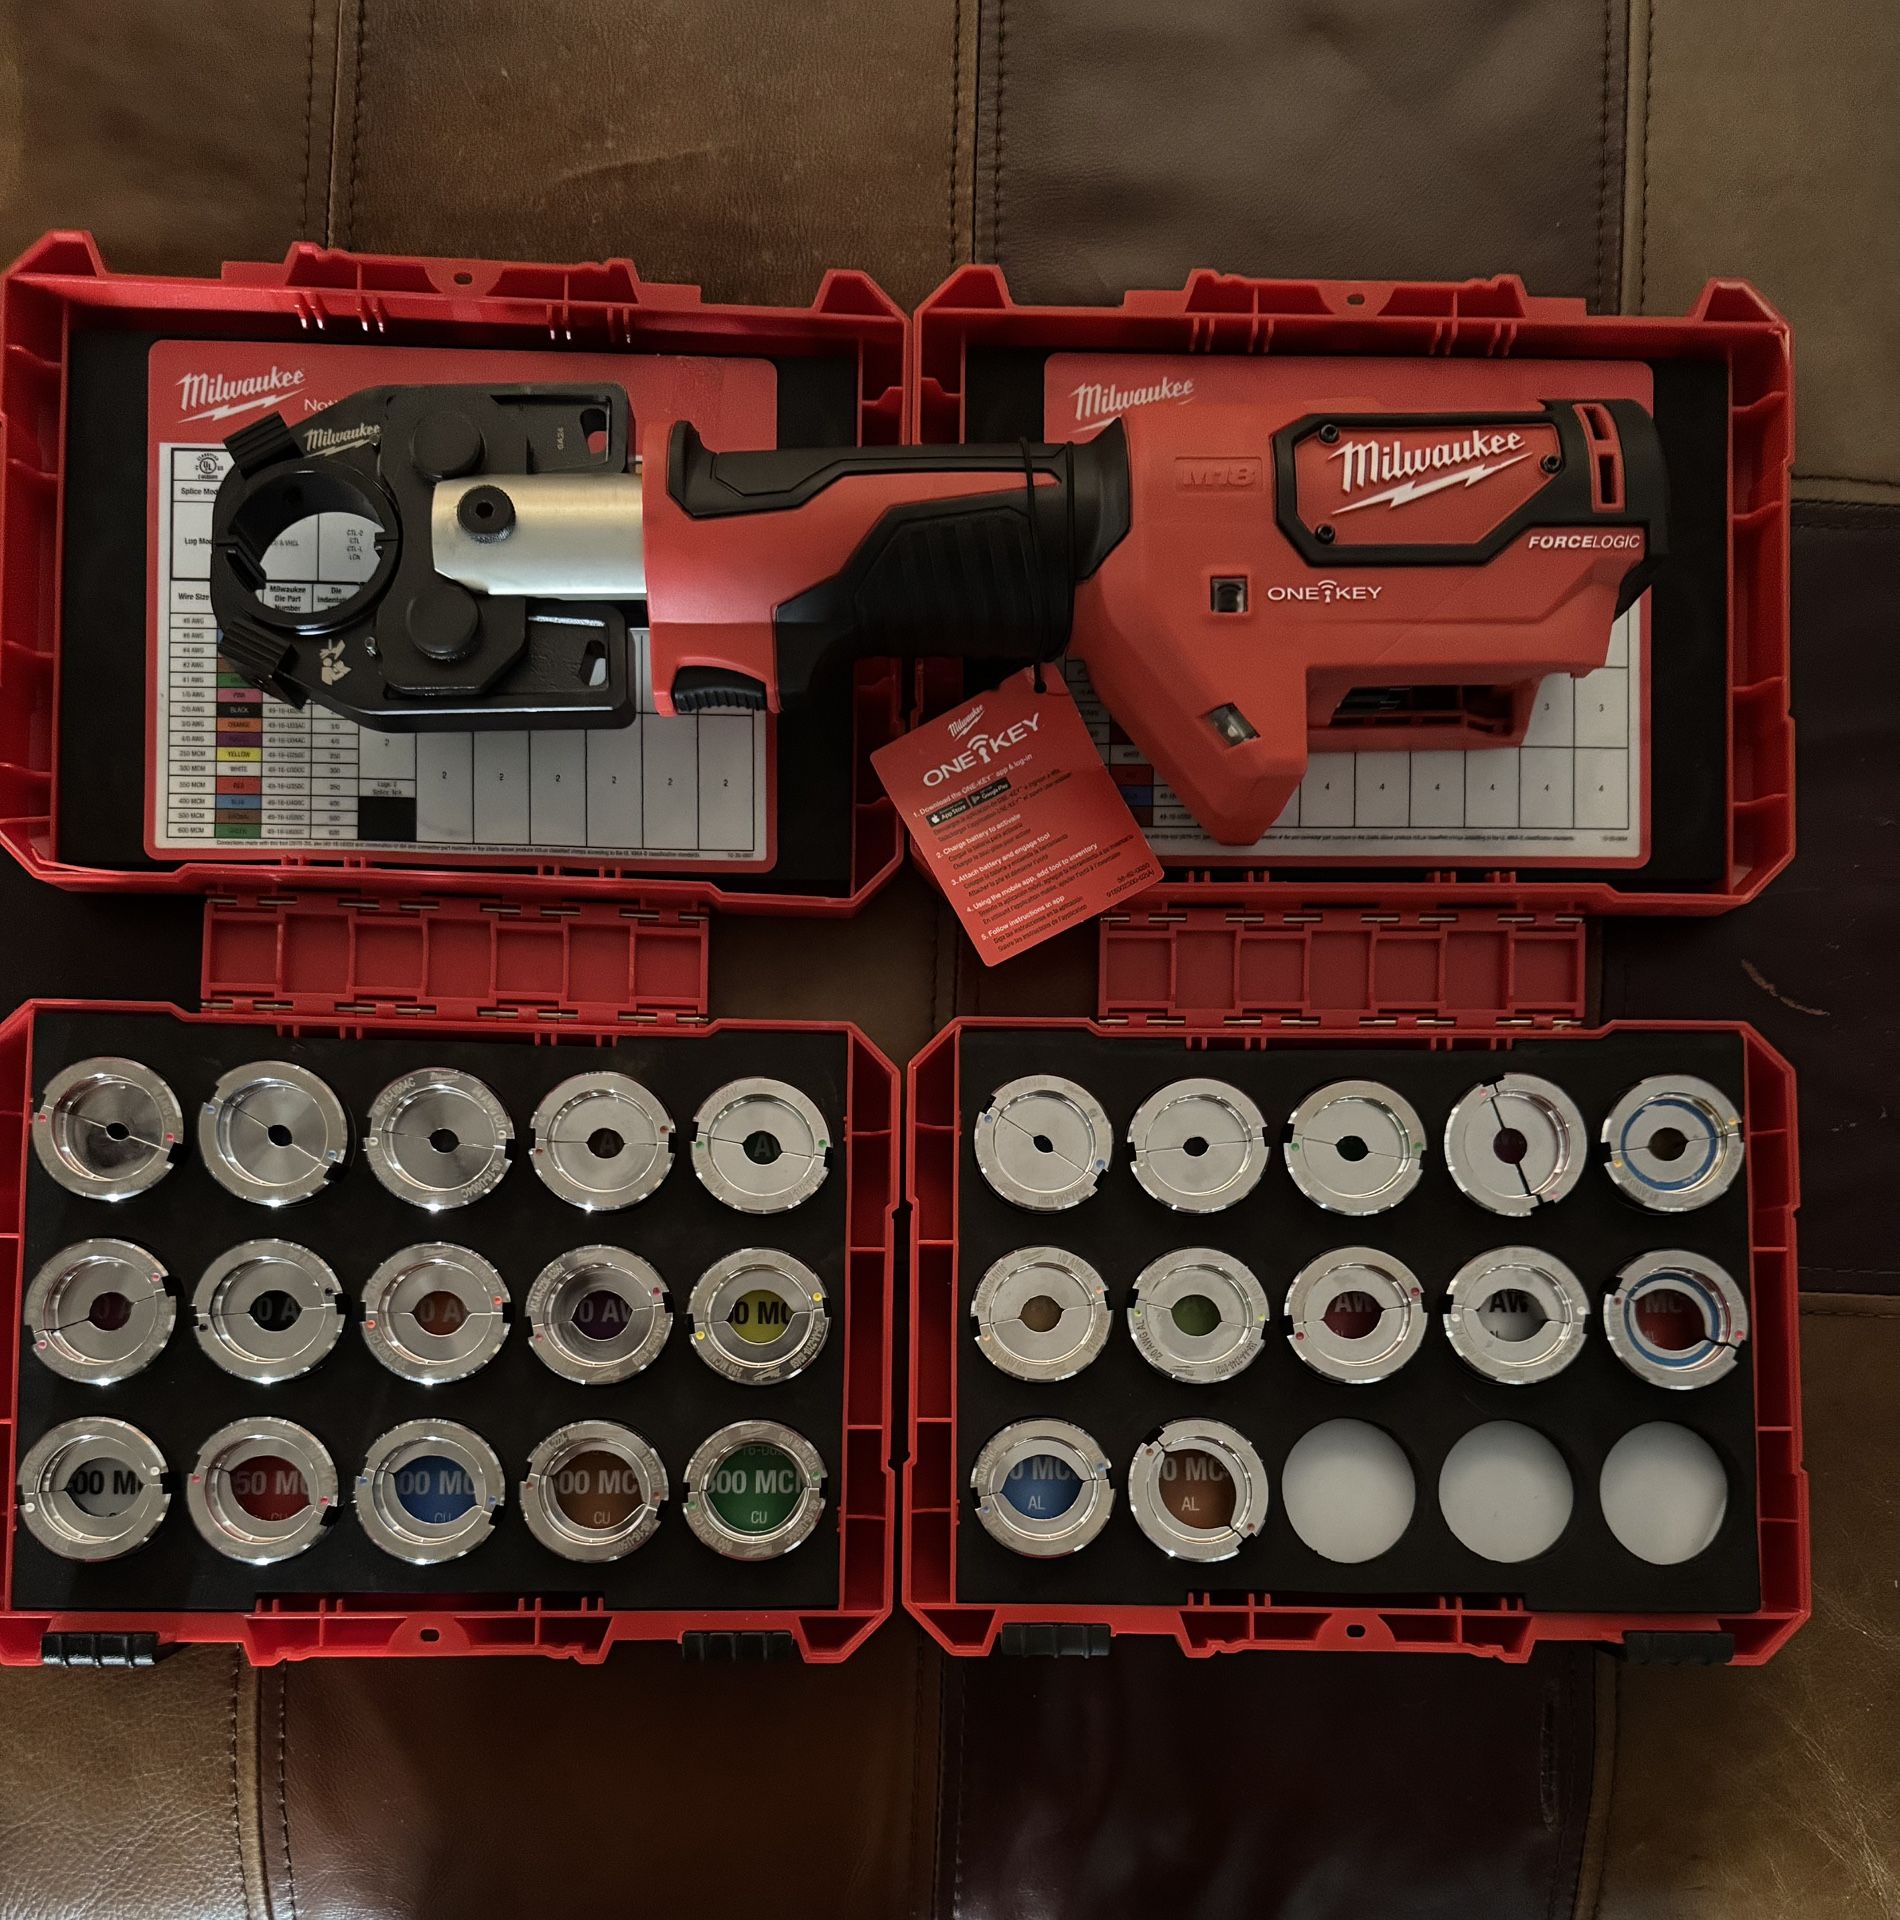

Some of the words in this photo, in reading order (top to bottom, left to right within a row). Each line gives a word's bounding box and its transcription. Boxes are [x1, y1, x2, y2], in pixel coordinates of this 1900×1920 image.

[176, 366, 304, 411] Milwaukee
[1069, 377, 1195, 421] Milwaukee
[303, 422, 381, 451] Milwaukee
[1327, 430, 1526, 493] Milwaukee
[181, 487, 202, 496] Splice
[184, 538, 198, 546] Lug
[1528, 535, 1640, 550] FORCELOGIC
[1267, 586, 1319, 601] ONE
[1336, 586, 1382, 600] KEY
[948, 704, 984, 736] Milwaukee
[923, 751, 977, 787] ONE
[989, 713, 1039, 752] KEY
[919, 794, 951, 815] Download
[950, 790, 961, 799] the
[995, 767, 1009, 778] app
[1013, 753, 1033, 768] log-in
[981, 787, 998, 799] Google
[940, 810, 952, 820] App
[951, 803, 965, 814] Store
[942, 839, 967, 856] Charge
[965, 828, 989, 845] battery
[995, 812, 1021, 829] activate
[957, 868, 979, 882] Attach
[979, 856, 1002, 872] battery
[1001, 850, 1014, 860] and
[1013, 839, 1038, 855] engage
[1036, 831, 1050, 842] tool
[972, 896, 992, 911] Using
[990, 891, 1001, 900] the
[1000, 881, 1022, 896] mobile
[1021, 874, 1036, 886] app,
[1035, 867, 1049, 878] add
[1048, 861, 1062, 871] tool
[1068, 842, 1098, 862] inventory
[988, 922, 1008, 936] Follow
[1008, 904, 1045, 926] instructions
[1052, 895, 1065, 905] app
[494, 1115, 506, 1127] CU
[1134, 1320, 1146, 1331] AL
[1137, 1330, 1154, 1352] AWG
[1148, 1347, 1163, 1362] 2/0
[804, 1455, 819, 1470] CU
[1028, 1496, 1046, 1511] AL
[1182, 1496, 1200, 1511] AL
[593, 1510, 611, 1526] CU
[688, 1510, 705, 1527] CU
[751, 1510, 768, 1525] CU
